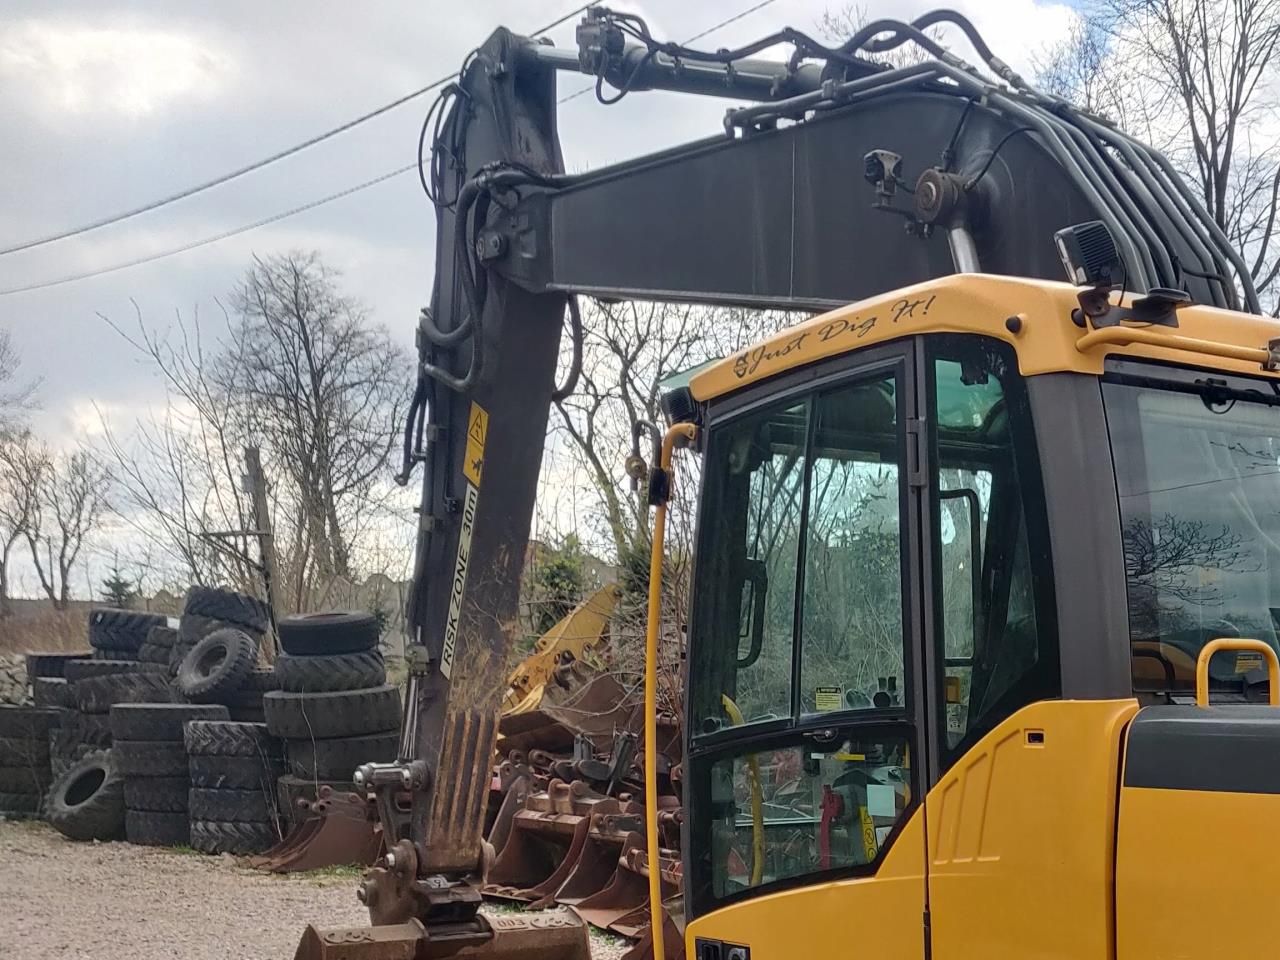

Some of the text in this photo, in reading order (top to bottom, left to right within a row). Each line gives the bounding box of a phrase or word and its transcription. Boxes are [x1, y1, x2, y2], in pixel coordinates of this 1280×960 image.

[748, 295, 937, 375] Just Dig It!
[443, 491, 476, 667] RISK ZONE 30m
